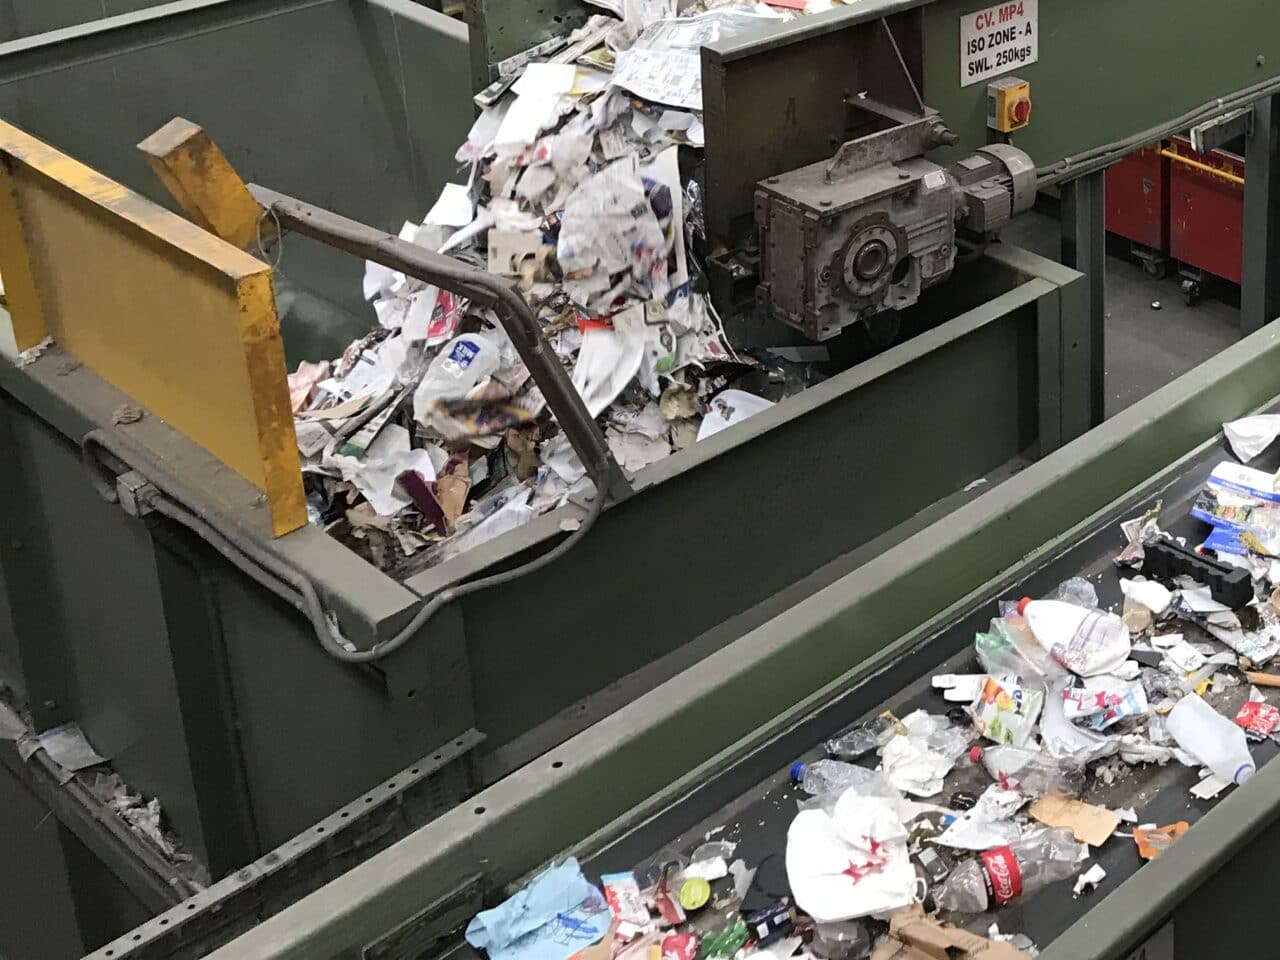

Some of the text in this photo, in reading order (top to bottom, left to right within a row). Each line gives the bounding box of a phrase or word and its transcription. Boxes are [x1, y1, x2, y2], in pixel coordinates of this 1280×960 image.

[975, 1, 1025, 31] CV. MP4
[967, 36, 985, 56] ISO
[988, 25, 1017, 49] ZONE
[1024, 21, 1032, 36] A
[967, 45, 1032, 77] SWL. 250kgs
